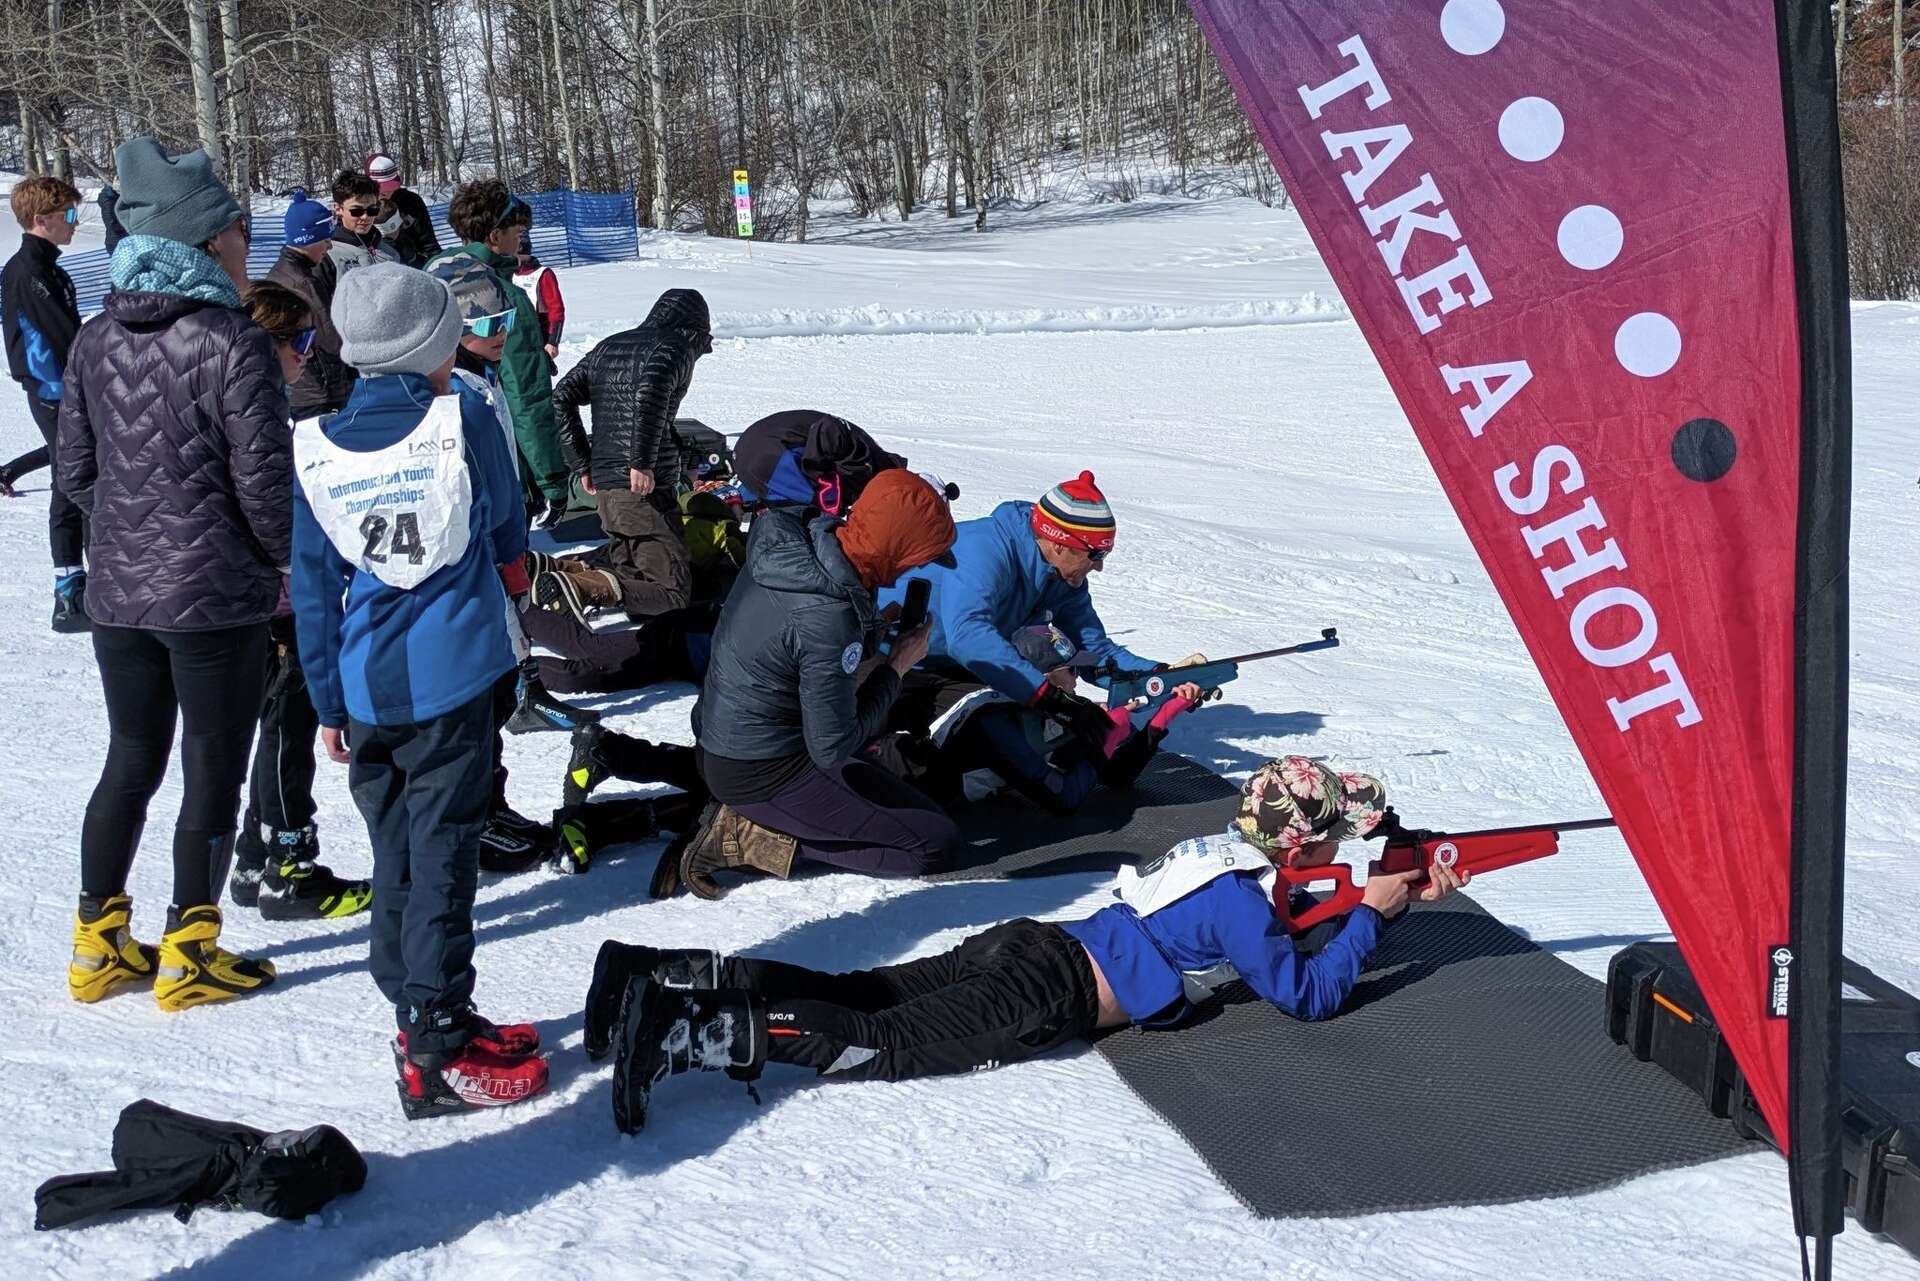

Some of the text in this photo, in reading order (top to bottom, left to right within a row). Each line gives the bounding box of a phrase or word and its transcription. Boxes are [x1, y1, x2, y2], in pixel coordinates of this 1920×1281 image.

[1297, 34, 1704, 733] TAKE A SHOT
[402, 465, 435, 482] Youth
[359, 511, 427, 566] 24
[1775, 966, 1789, 1016] STRIKE
